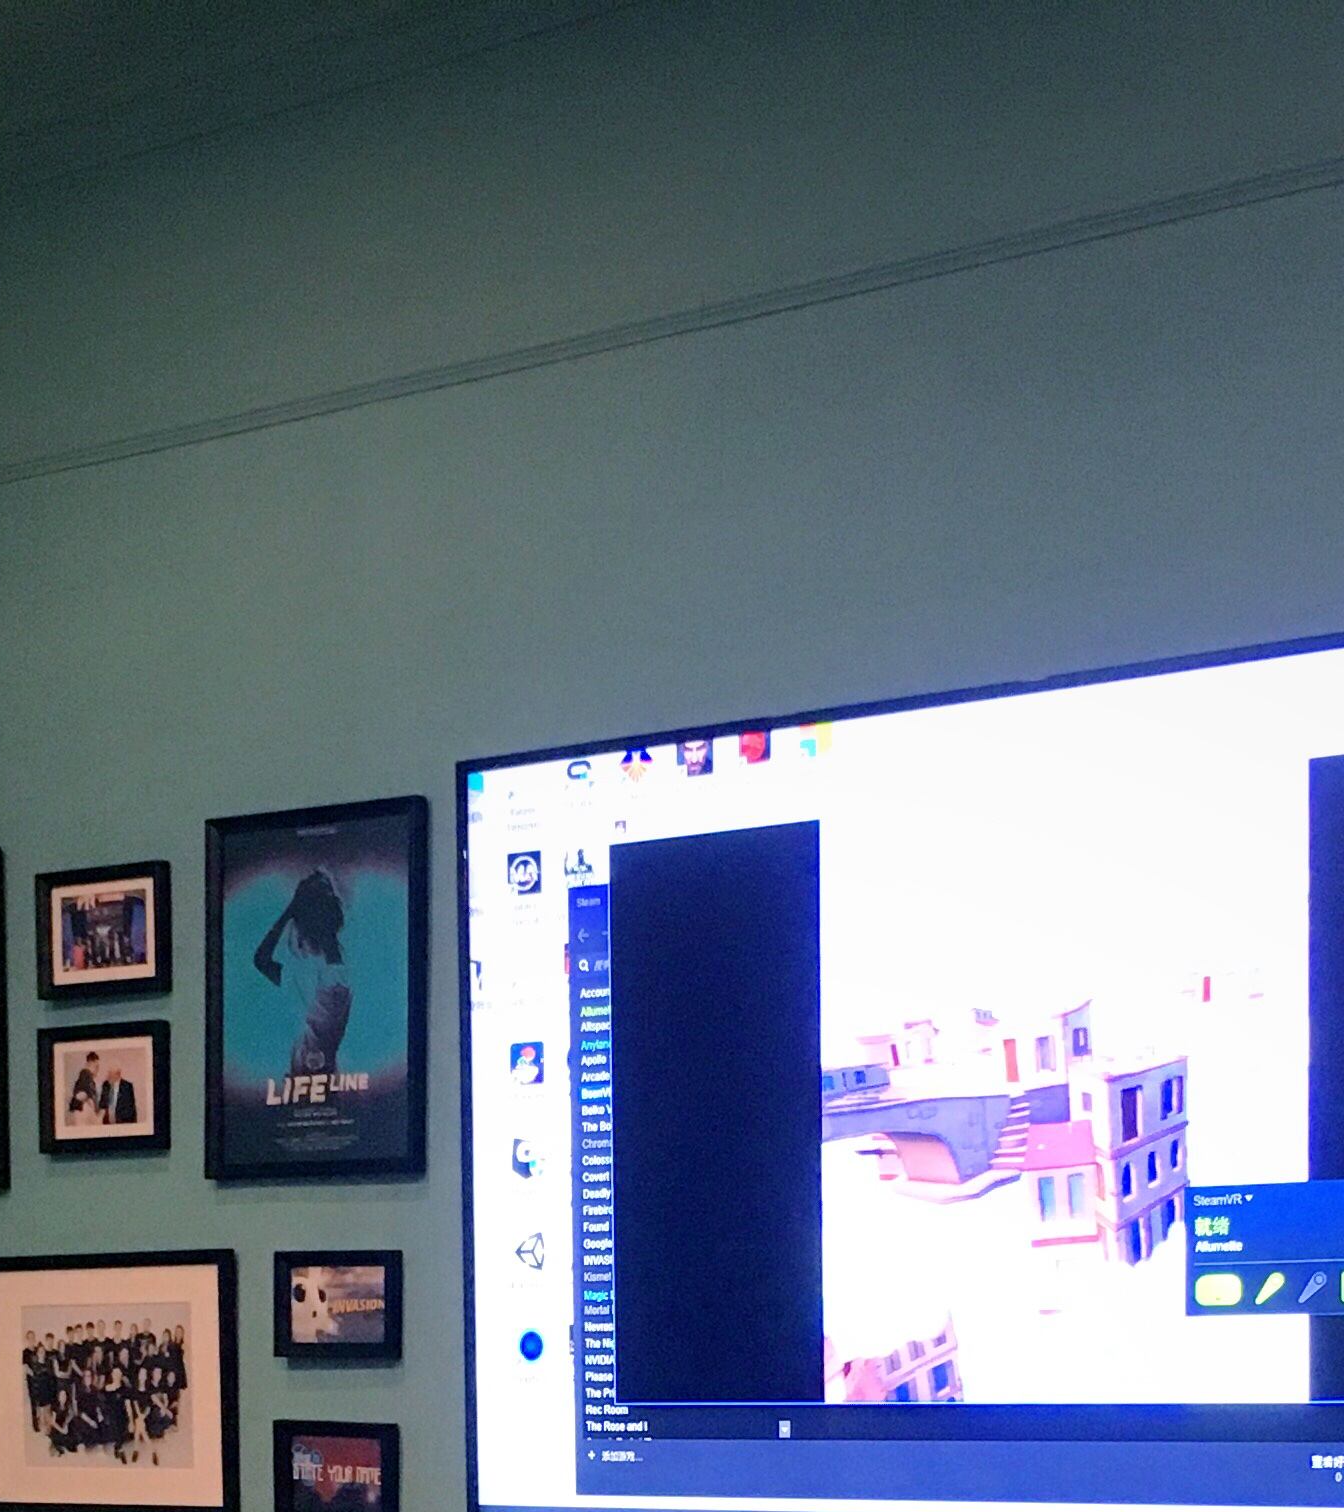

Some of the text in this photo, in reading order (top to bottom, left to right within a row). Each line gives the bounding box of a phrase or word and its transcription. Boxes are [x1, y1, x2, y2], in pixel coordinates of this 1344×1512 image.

[581, 1055, 607, 1067] Apollo
[582, 1121, 598, 1133] The
[582, 1171, 610, 1183] Covert
[582, 1187, 611, 1200] Deadly
[1193, 1193, 1243, 1206] SteamVR
[583, 1220, 610, 1233] Found
[1194, 1215, 1230, 1236] 就绪
[1195, 1240, 1244, 1253] Allumette
[584, 1290, 609, 1302] Magic
[583, 1305, 610, 1316] Mortal
[585, 1338, 602, 1349] The
[585, 1371, 613, 1382] Please
[585, 1388, 602, 1399] The
[585, 1405, 629, 1415] Rec Room
[586, 1421, 602, 1432] The
[603, 1421, 625, 1432] Rose
[626, 1421, 643, 1432] and
